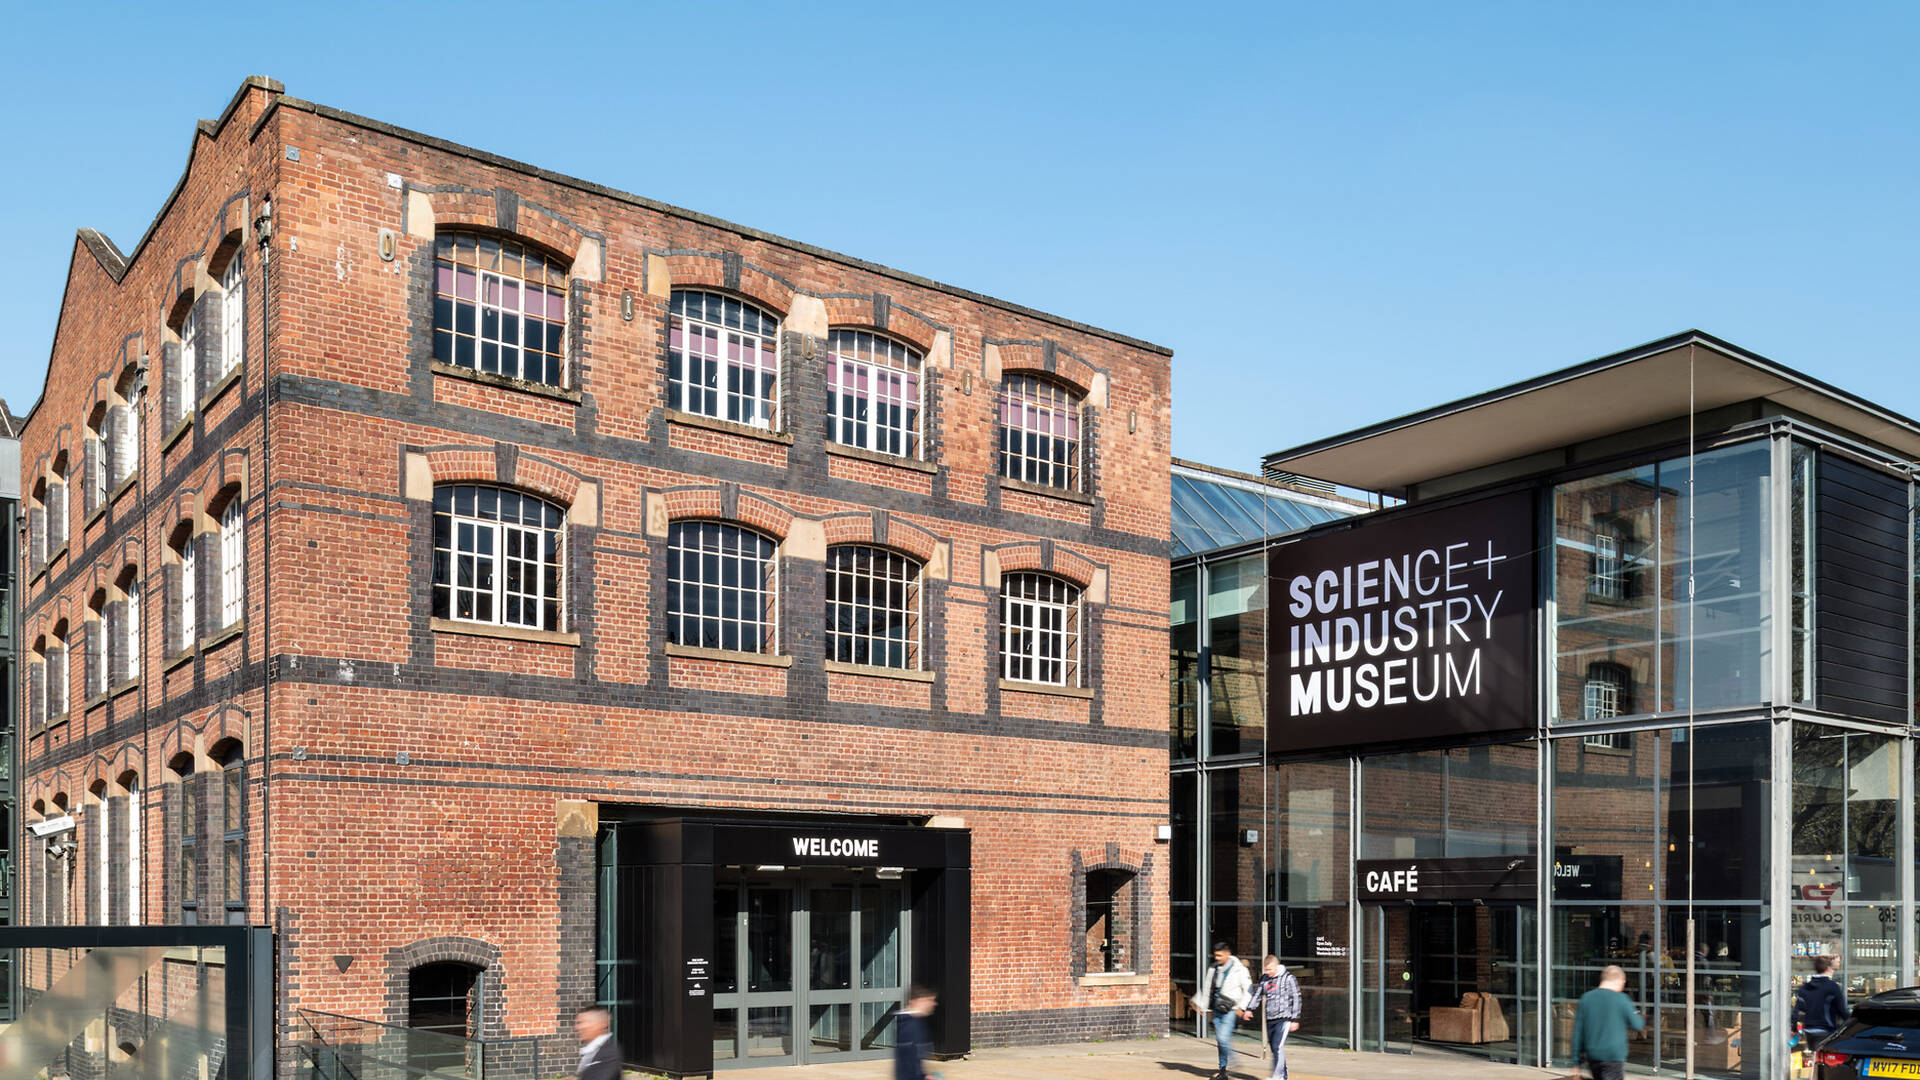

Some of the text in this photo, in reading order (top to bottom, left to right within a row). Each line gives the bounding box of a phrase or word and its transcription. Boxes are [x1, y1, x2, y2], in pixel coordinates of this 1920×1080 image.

[1289, 540, 1507, 618] SCIENCE+
[1290, 590, 1503, 668] INDUSTRY
[1290, 648, 1481, 716] MUSEUM
[793, 837, 879, 857] WELCOME
[1366, 865, 1418, 892] CAFÉ
[1872, 1061, 1899, 1073] MV17
